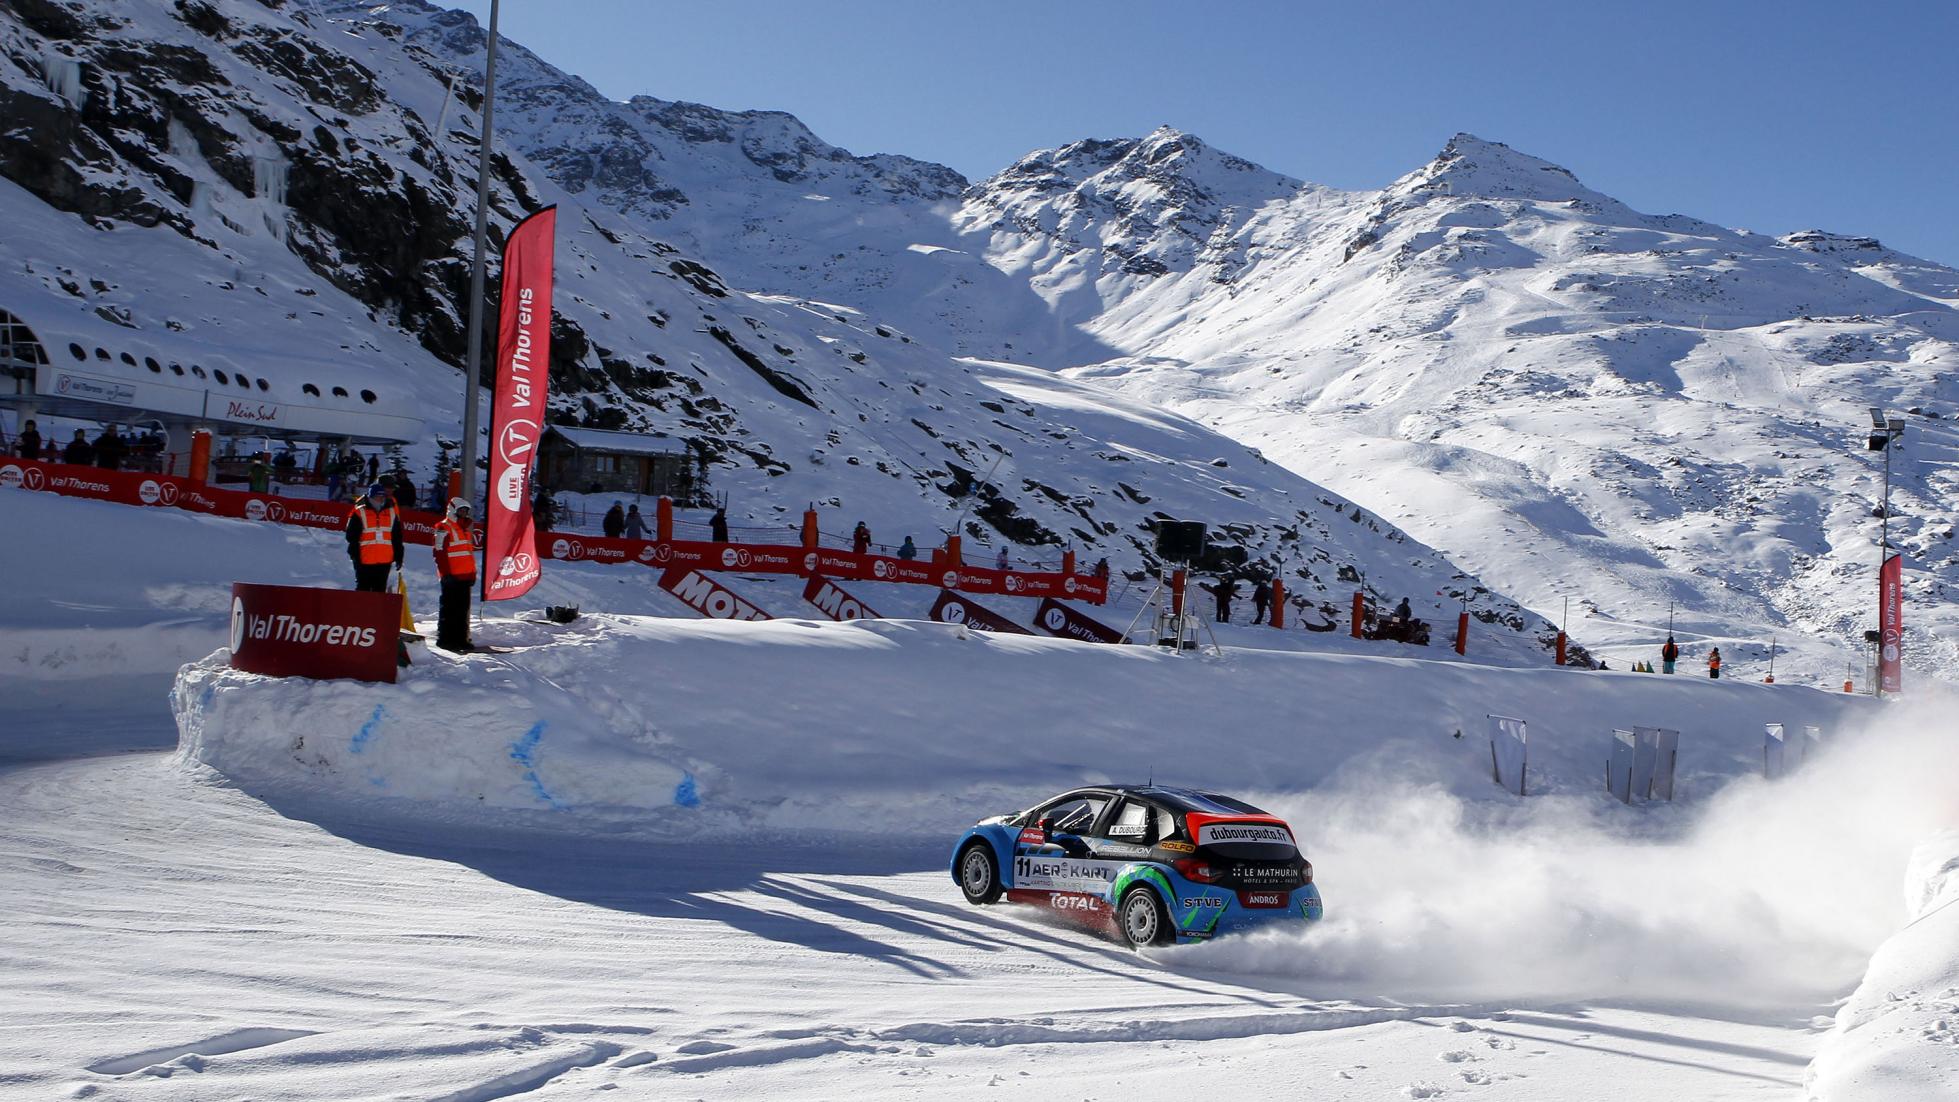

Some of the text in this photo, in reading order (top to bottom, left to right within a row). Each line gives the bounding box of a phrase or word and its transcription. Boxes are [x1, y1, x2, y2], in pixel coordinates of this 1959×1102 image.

[512, 287, 534, 372] Thorens
[511, 376, 532, 409] Val
[227, 401, 278, 421] Plein Sud
[50, 476, 67, 487] Val
[68, 477, 111, 493] Thorens
[508, 476, 518, 499] LIVE
[289, 510, 303, 520] Val
[403, 521, 416, 532] Val
[586, 547, 599, 556] Val
[599, 547, 625, 558] Thorens
[753, 554, 764, 563] Val
[764, 554, 789, 564] Thorens
[833, 557, 857, 569] Thorens
[505, 570, 539, 588] Thorens
[249, 613, 377, 647] Val Thorens
[1067, 622, 1084, 637] Val
[1210, 826, 1287, 842] dubourgauto.fr
[1102, 845, 1152, 855] REBELLION
[1017, 857, 1031, 878] 11
[1244, 868, 1298, 877] LE MATHURIN
[1049, 892, 1099, 911] TOTAL
[1184, 897, 1222, 909] STVE
[1249, 895, 1279, 905] ANDROS
